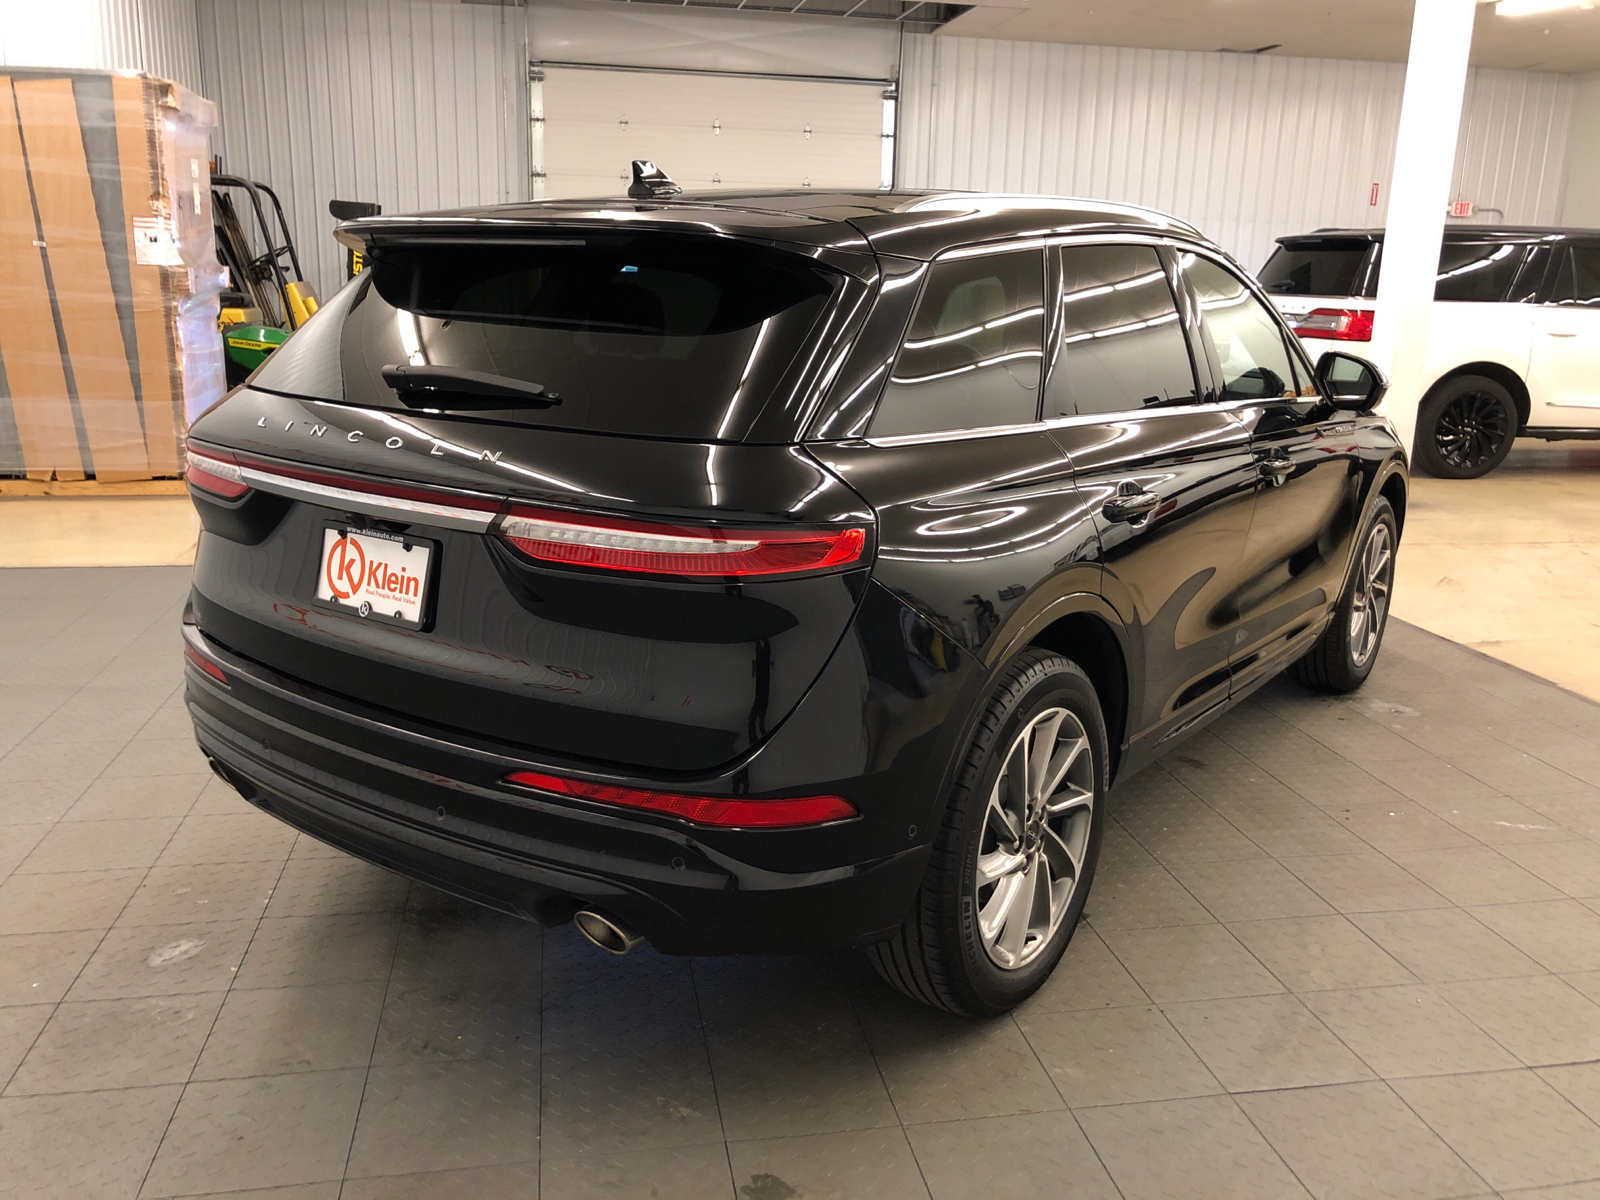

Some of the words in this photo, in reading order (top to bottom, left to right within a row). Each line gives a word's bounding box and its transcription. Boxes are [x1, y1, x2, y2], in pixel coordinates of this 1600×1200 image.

[1454, 202, 1470, 215] EXIT
[257, 416, 502, 463] LINCOLN
[346, 526, 404, 543] www.kleinauto.com
[367, 559, 420, 598] Klein
[365, 588, 375, 596] Real
[375, 590, 391, 600] People.
[391, 594, 402, 602] Real
[402, 597, 417, 606] Value.
[963, 901, 981, 977] MICHELIN
